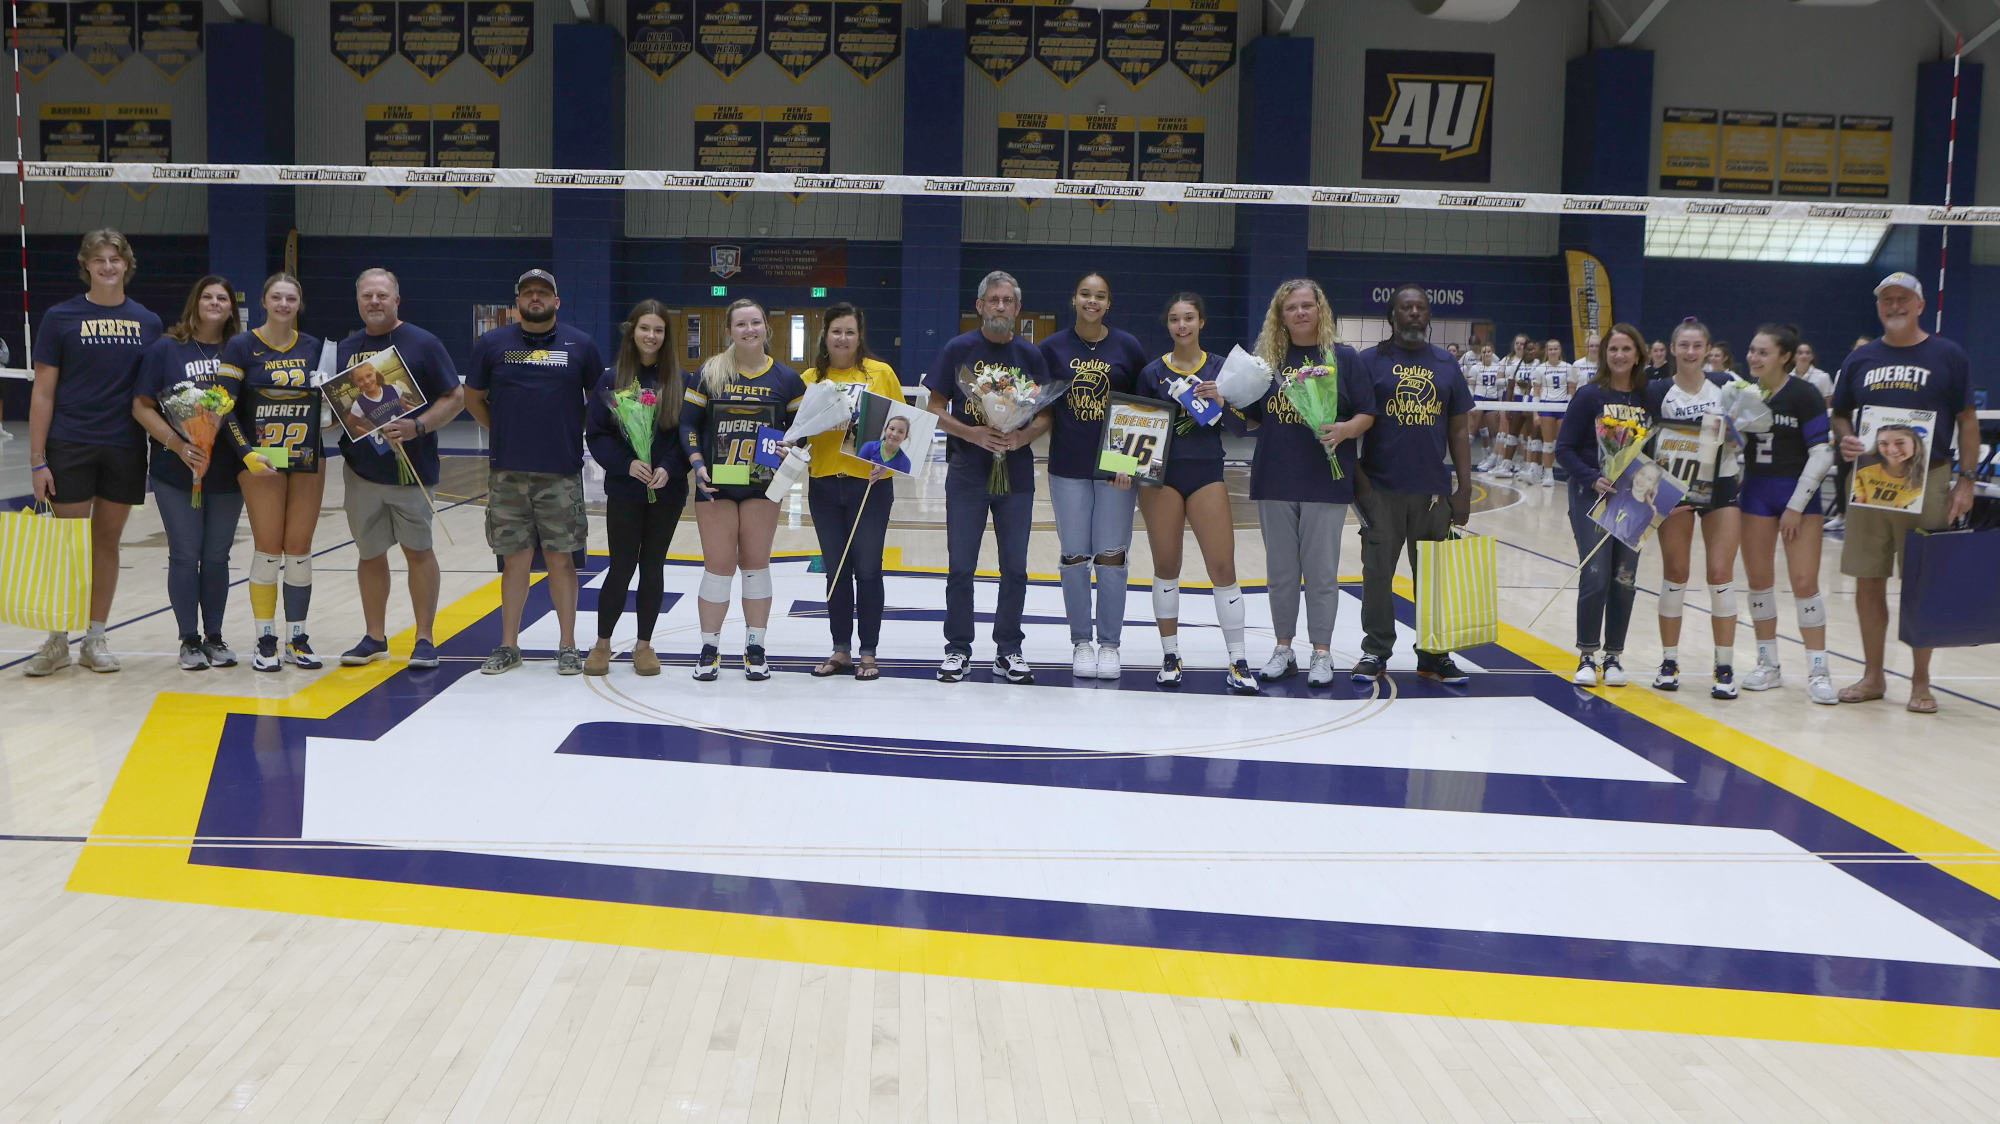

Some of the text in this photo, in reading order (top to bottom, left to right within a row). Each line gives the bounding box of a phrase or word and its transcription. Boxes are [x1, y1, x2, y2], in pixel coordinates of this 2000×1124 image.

[647, 33, 672, 41] NCAA
[629, 43, 691, 51] APPEARANCE
[383, 111, 413, 119] TENNIS
[451, 111, 481, 119] TENNIS
[713, 112, 743, 120] TENNIS
[1381, 82, 1483, 149] AU
[1016, 120, 1047, 128] TENNIS
[1087, 122, 1117, 130] TENNIS
[1156, 123, 1188, 131] TENNIS
[28, 166, 113, 177] AVERETT UNIVERSITY
[154, 167, 238, 178] AVERETT UNIVERSITY
[280, 170, 366, 180] AVERETT UNIVERSITY
[407, 172, 494, 182] AVERETT UNIVERSITY
[536, 174, 624, 184] AVERETT UNIVERSITY
[666, 176, 754, 187] AVERETT UNIVERSITY
[796, 178, 884, 189] AVERETT UNIVERSITY
[926, 180, 1014, 192] AVERETT UNIVERSITY
[1056, 184, 1144, 196] AVERETT UNIVERSITY
[1185, 187, 1273, 199] AVERETT UNIVERSITY
[1314, 191, 1400, 203] AVERETT UNIVERSITY
[1440, 194, 1525, 206] AVERETT UNIVERSITY
[1564, 199, 1649, 210] AVERETT UNIVERSITY
[1688, 202, 1771, 214] AVERETT UNIVERSITY
[1809, 206, 1892, 218] AVERETT UNIVERSITY
[713, 287, 726, 296] EXIT
[812, 288, 826, 297] EXIT
[1372, 287, 1464, 305] COSIONS
[80, 319, 141, 337] AVERETT
[81, 337, 142, 345] VOLLEYBALL
[185, 359, 220, 378] AVER
[264, 359, 307, 370] AVERETT
[1070, 358, 1111, 373] Senior
[271, 369, 306, 386] 22
[1393, 364, 1434, 379] Senior
[1864, 365, 1931, 388] AVERETT
[1553, 376, 1560, 389] 9
[1870, 381, 1919, 391] VOLLEYBALL
[724, 384, 771, 396] AVERETT
[1067, 393, 1108, 411] Volleyb
[1386, 398, 1442, 416] Volleyball
[255, 404, 310, 418] AVERETT
[1074, 409, 1105, 421] SQUA
[1114, 414, 1168, 429] AVERETT
[260, 423, 308, 458] 22
[761, 437, 777, 455] 19
[1661, 439, 1699, 453] AVERE
[1120, 433, 1158, 467] 16
[1755, 432, 1774, 464] 2
[1868, 479, 1905, 490] AVERET
[1872, 487, 1899, 502] 10
